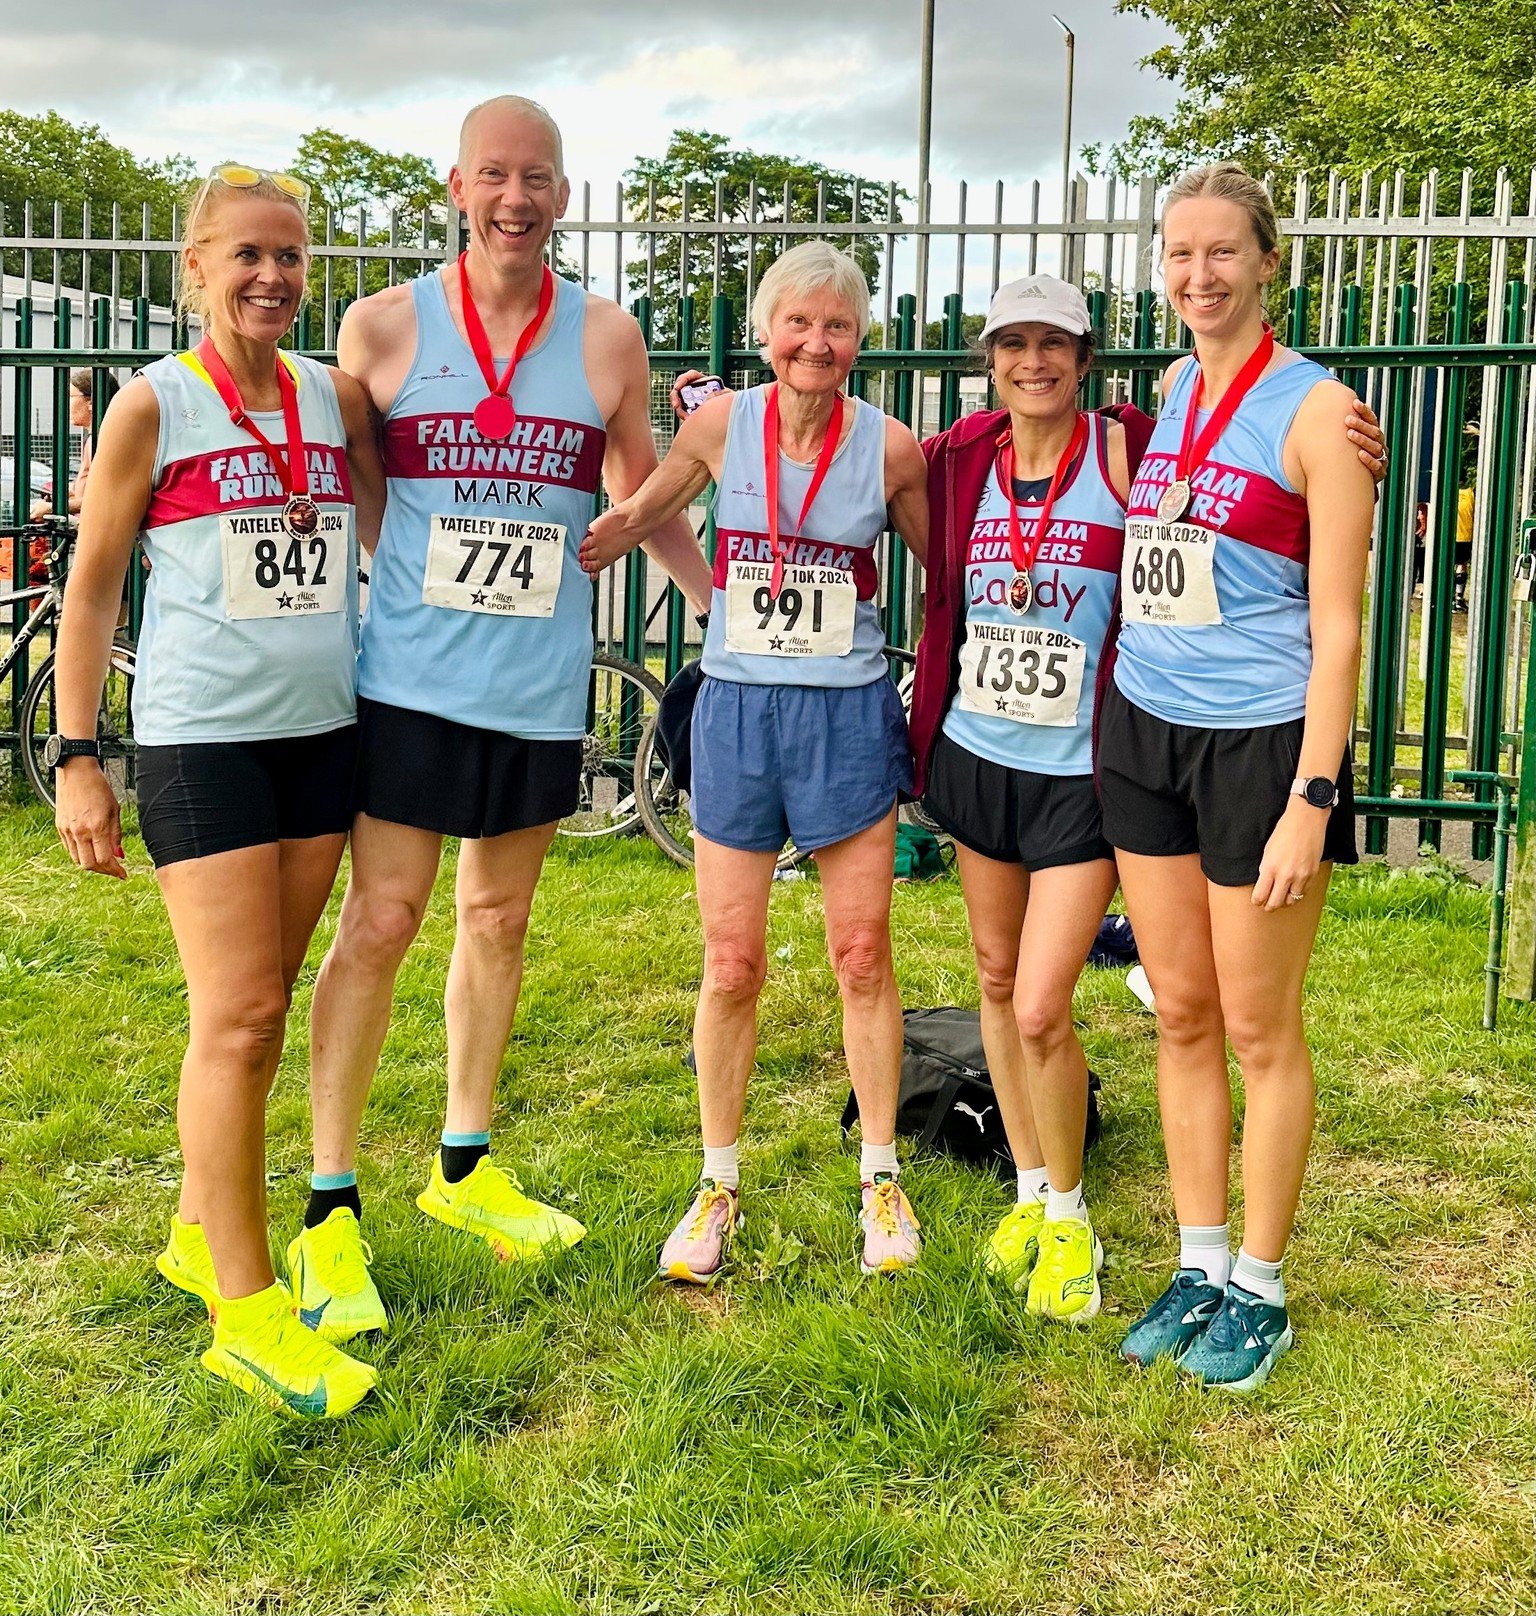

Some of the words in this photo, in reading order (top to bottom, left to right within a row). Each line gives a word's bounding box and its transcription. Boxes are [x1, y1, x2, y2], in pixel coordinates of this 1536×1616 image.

[417, 419, 585, 455] FARHAM
[426, 446, 577, 480] RUNNERS
[454, 480, 547, 508] MARK
[229, 516, 286, 534] YATELEY
[439, 516, 496, 535] YATELEY
[500, 522, 525, 539] 10K
[527, 525, 559, 542] 2024
[1156, 525, 1173, 541] 10K
[1174, 527, 1208, 544] 2024
[255, 537, 327, 588] 842
[455, 538, 534, 590] 774
[970, 542, 1084, 563] RUNERS
[792, 569, 815, 584] 10K
[819, 569, 849, 585] 2024
[1132, 546, 1185, 598] 680
[294, 602, 320, 610] SPORTS
[487, 603, 516, 611] SPORTS
[970, 568, 1087, 623] Cady
[753, 586, 823, 633] 991
[1151, 612, 1176, 621] SPORTS
[974, 624, 1016, 642] YATELEY
[1020, 629, 1043, 646] 10K
[976, 645, 1068, 699] 1335
[1008, 709, 1035, 719] SPORTS
